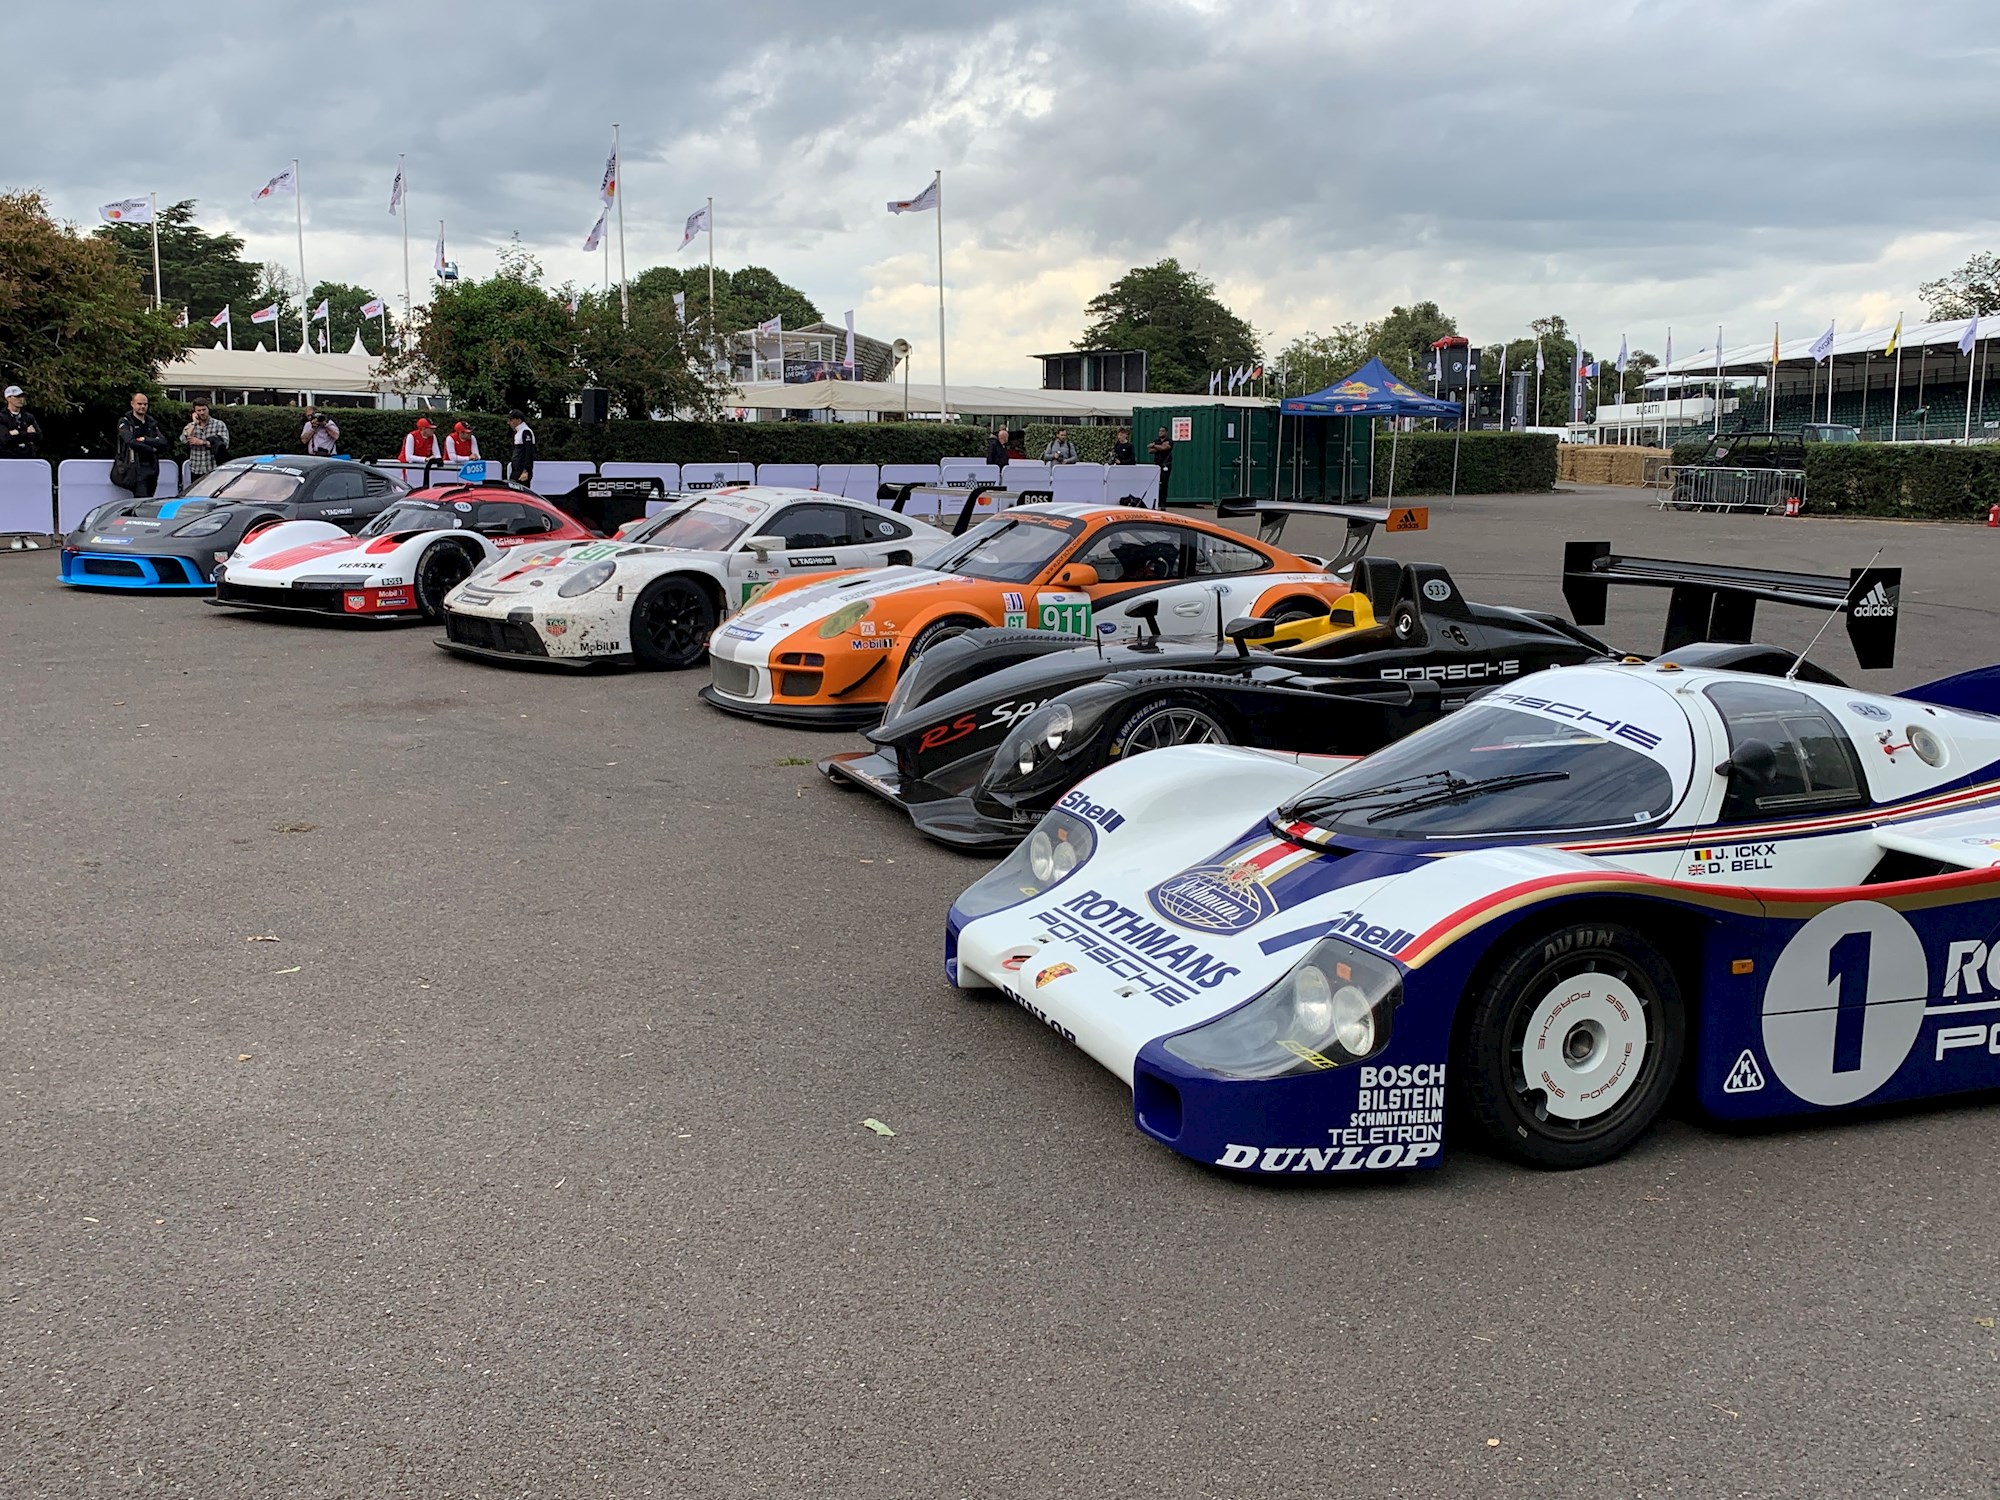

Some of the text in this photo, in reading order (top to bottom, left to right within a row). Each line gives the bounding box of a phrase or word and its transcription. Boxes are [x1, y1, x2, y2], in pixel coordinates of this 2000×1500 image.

[1636, 404, 1660, 415] BUGATTI
[466, 464, 484, 474] BOSS
[588, 482, 652, 490] PORSCHE
[1024, 495, 1049, 504] BOSS
[338, 562, 387, 570] PENSKE
[383, 577, 402, 585] BOSS
[1428, 584, 1447, 596] 533
[378, 590, 398, 598] Mobil
[1043, 605, 1087, 636] 911
[1853, 603, 1895, 618] adidas
[580, 642, 609, 651] Mobil
[852, 640, 882, 649] Mobil
[915, 621, 946, 652] MICHELIN
[1380, 660, 1519, 681] PORSCHE
[1120, 699, 1167, 737] MICHELIN
[918, 713, 977, 754] RS
[1060, 790, 1126, 834] Shell
[1714, 843, 1777, 860] J. ICKX
[1708, 857, 1773, 874] D. BELL
[1063, 889, 1242, 989] ROTHMANS
[1543, 929, 1614, 963] AVON
[1029, 911, 1191, 1008] PORSCHE
[1605, 993, 1630, 1022] 956
[1827, 930, 1873, 1075] 1
[1537, 990, 1592, 1050] PORSCHE
[1360, 1064, 1446, 1088] BOSCH
[1580, 1042, 1633, 1102] PORSCHE
[1541, 1071, 1566, 1099] 956
[1358, 1087, 1444, 1111] BILSTEIN
[1350, 1109, 1443, 1127] SCHMITTHELM
[1328, 1124, 1442, 1145] TELETRON
[1215, 1143, 1440, 1172] DUNLOP
